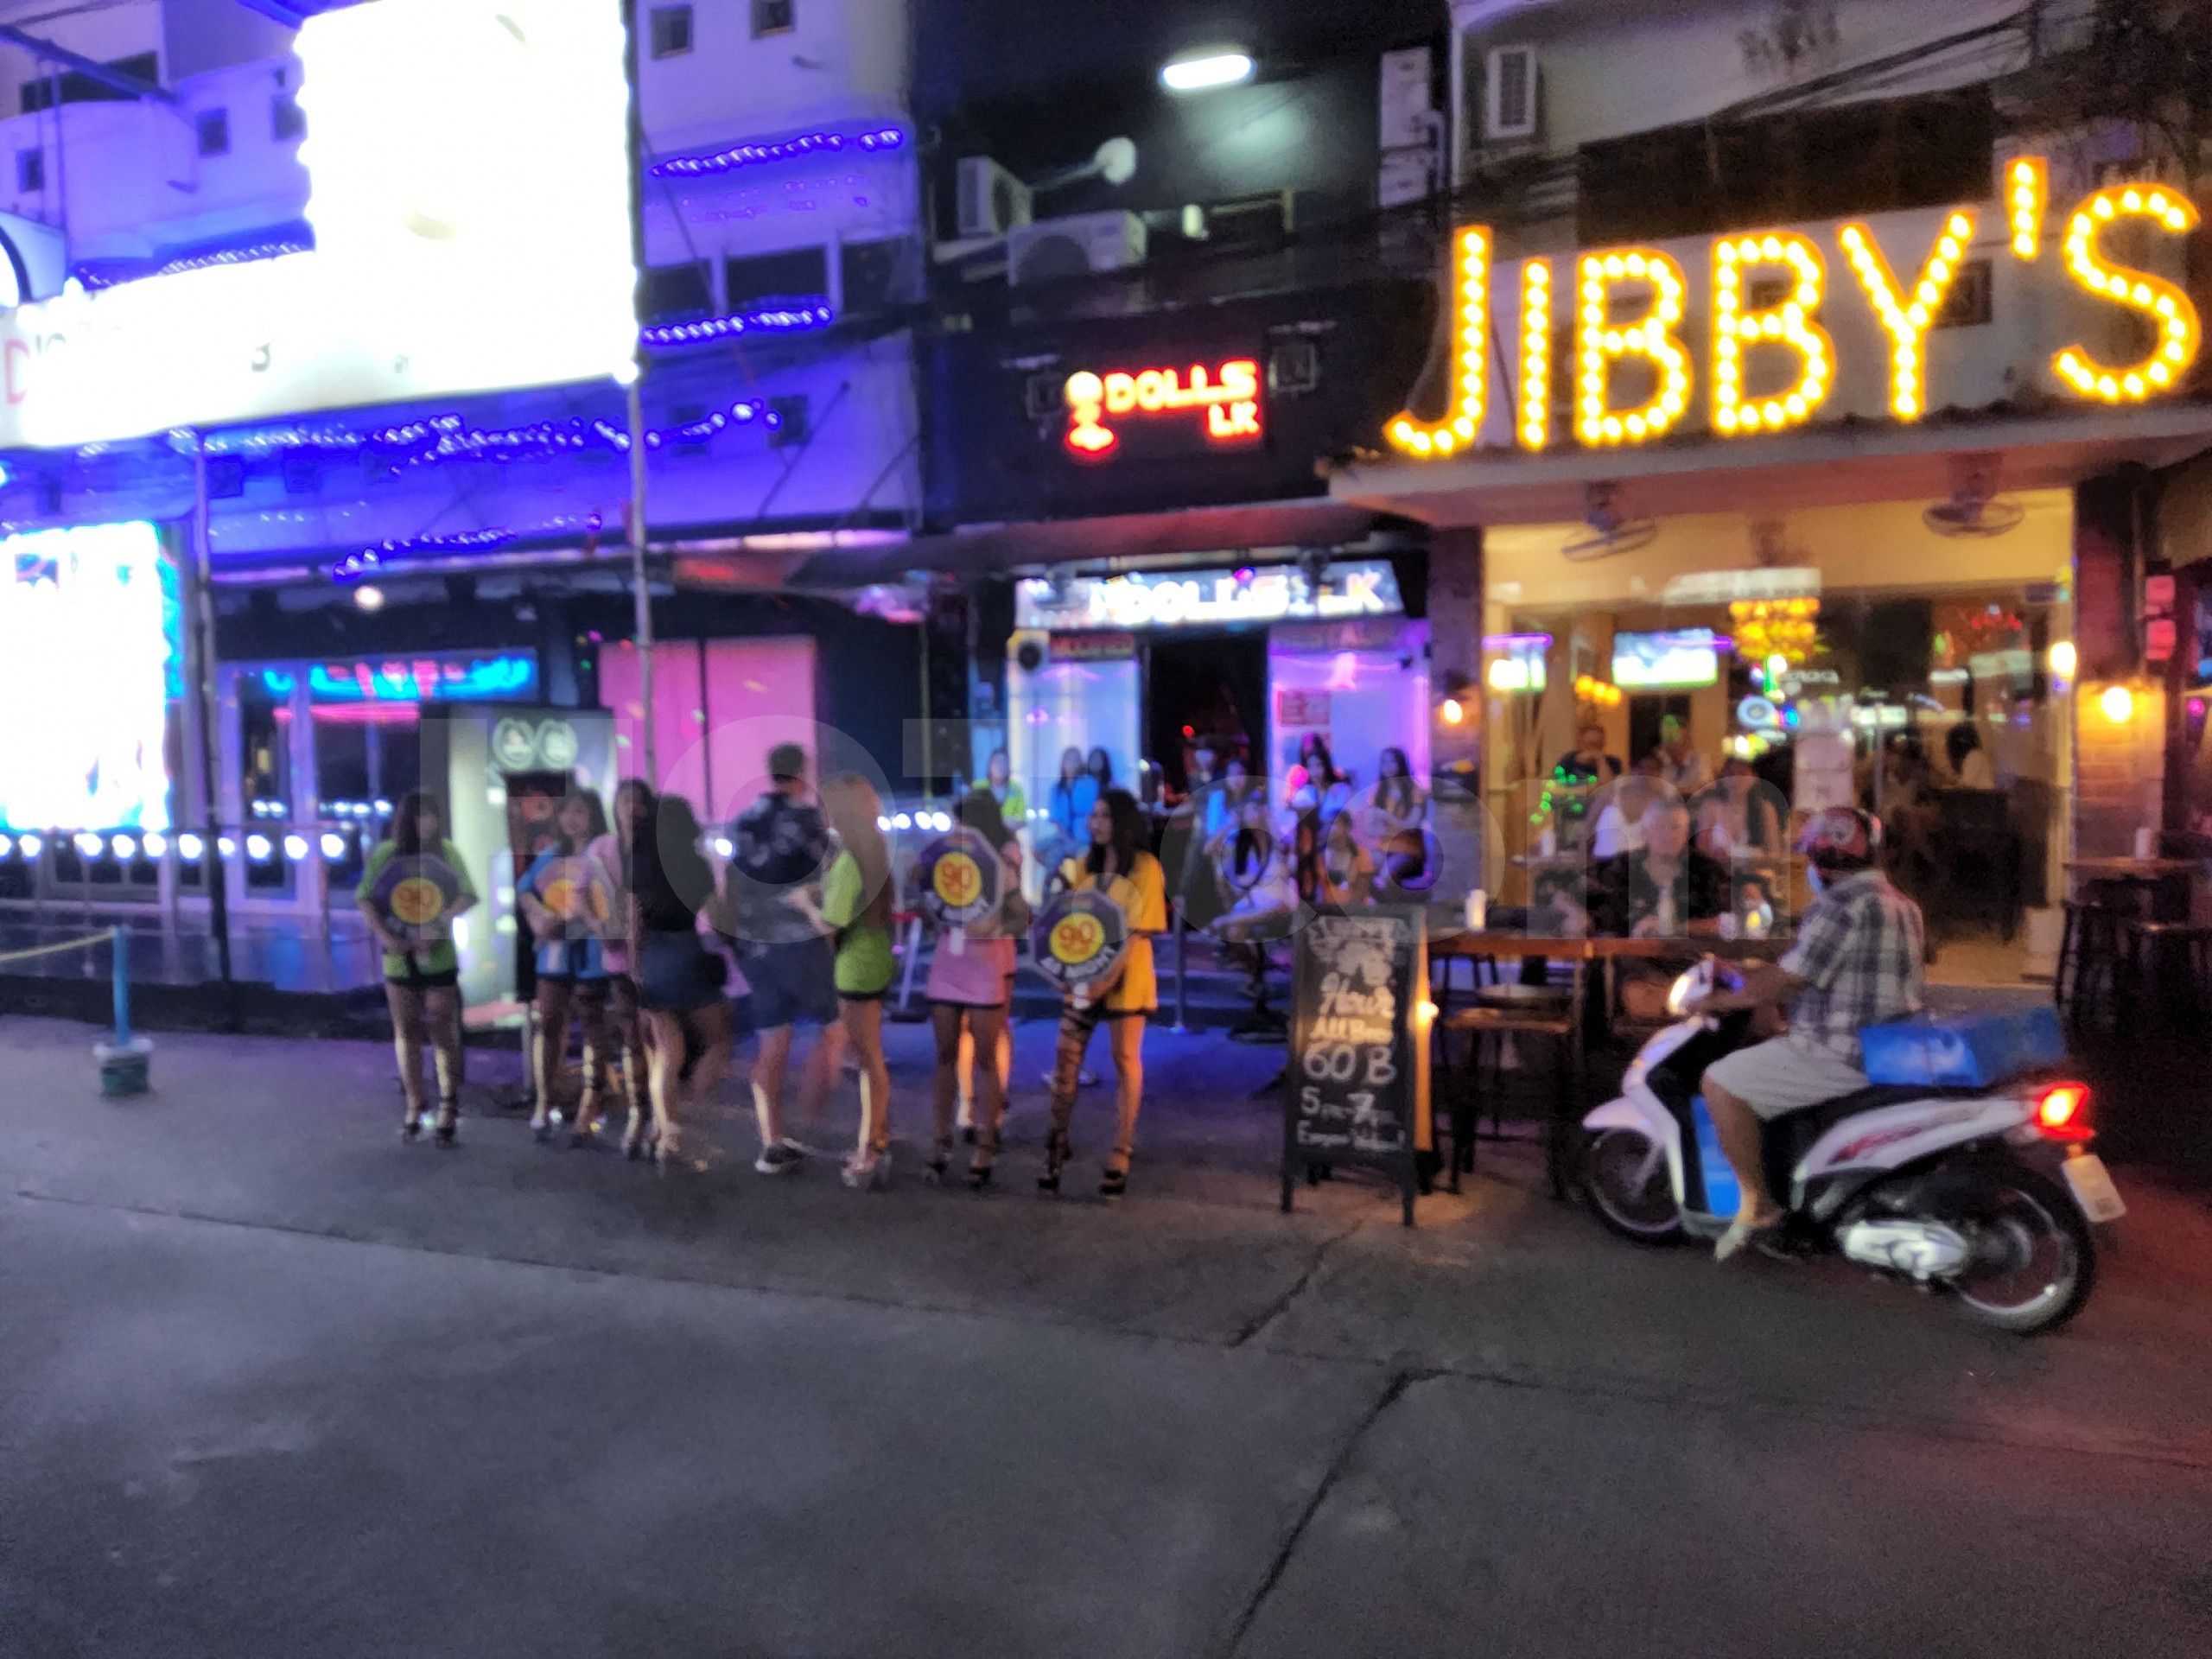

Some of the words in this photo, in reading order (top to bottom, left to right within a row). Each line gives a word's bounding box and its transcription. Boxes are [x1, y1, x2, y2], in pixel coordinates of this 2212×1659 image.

[1385, 156, 2202, 459] JIBBY'S
[1103, 359, 1258, 413] DOLLS
[1303, 1042, 1356, 1082] 60
[1367, 1046, 1397, 1084] B
